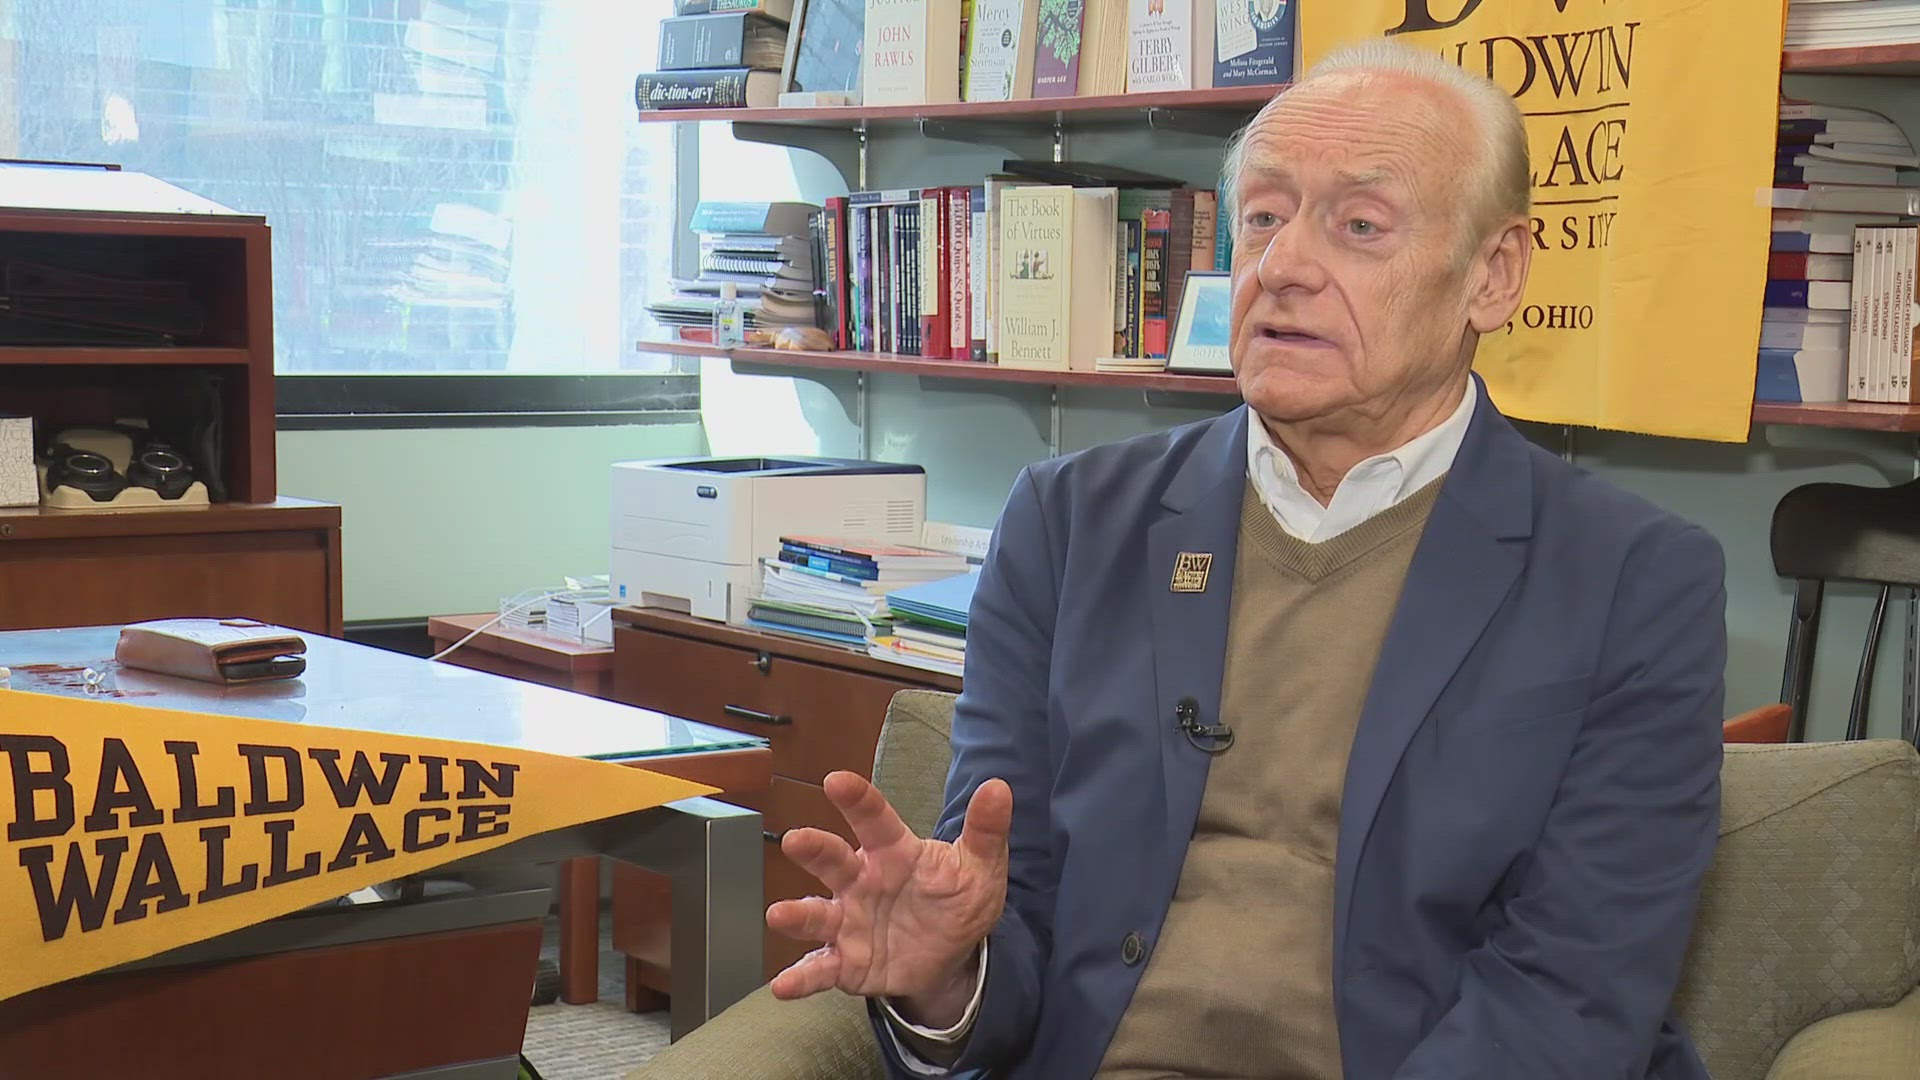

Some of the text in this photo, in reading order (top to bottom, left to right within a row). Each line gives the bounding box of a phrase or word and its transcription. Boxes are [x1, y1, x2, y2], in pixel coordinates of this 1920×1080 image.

[877, 25, 911, 46] JOHN
[1138, 37, 1173, 56] TERRY
[874, 50, 914, 68] RAWLS
[1132, 54, 1181, 75] GILBERT
[1233, 69, 1246, 78] Mary
[1247, 66, 1278, 77] McCormack
[1248, 56, 1275, 67] Fitzgerald
[1531, 119, 1627, 188] ACE
[1007, 198, 1060, 217] The Book
[1006, 221, 1061, 240] of Virtues
[953, 202, 964, 332] 14,000 Quips & Quotes
[1522, 304, 1594, 330] OHIO
[1872, 297, 1880, 337] RESILIENCE
[1882, 292, 1890, 340] MINDFULNESS
[1892, 271, 1902, 354] AUTHENTIC LEADERSHIP
[1005, 316, 1059, 343] William J.
[1903, 313, 1911, 357] PERSUASION
[1011, 340, 1051, 360] Bennett
[0, 733, 521, 843] BALDWIN
[19, 804, 512, 943] WALLACE
